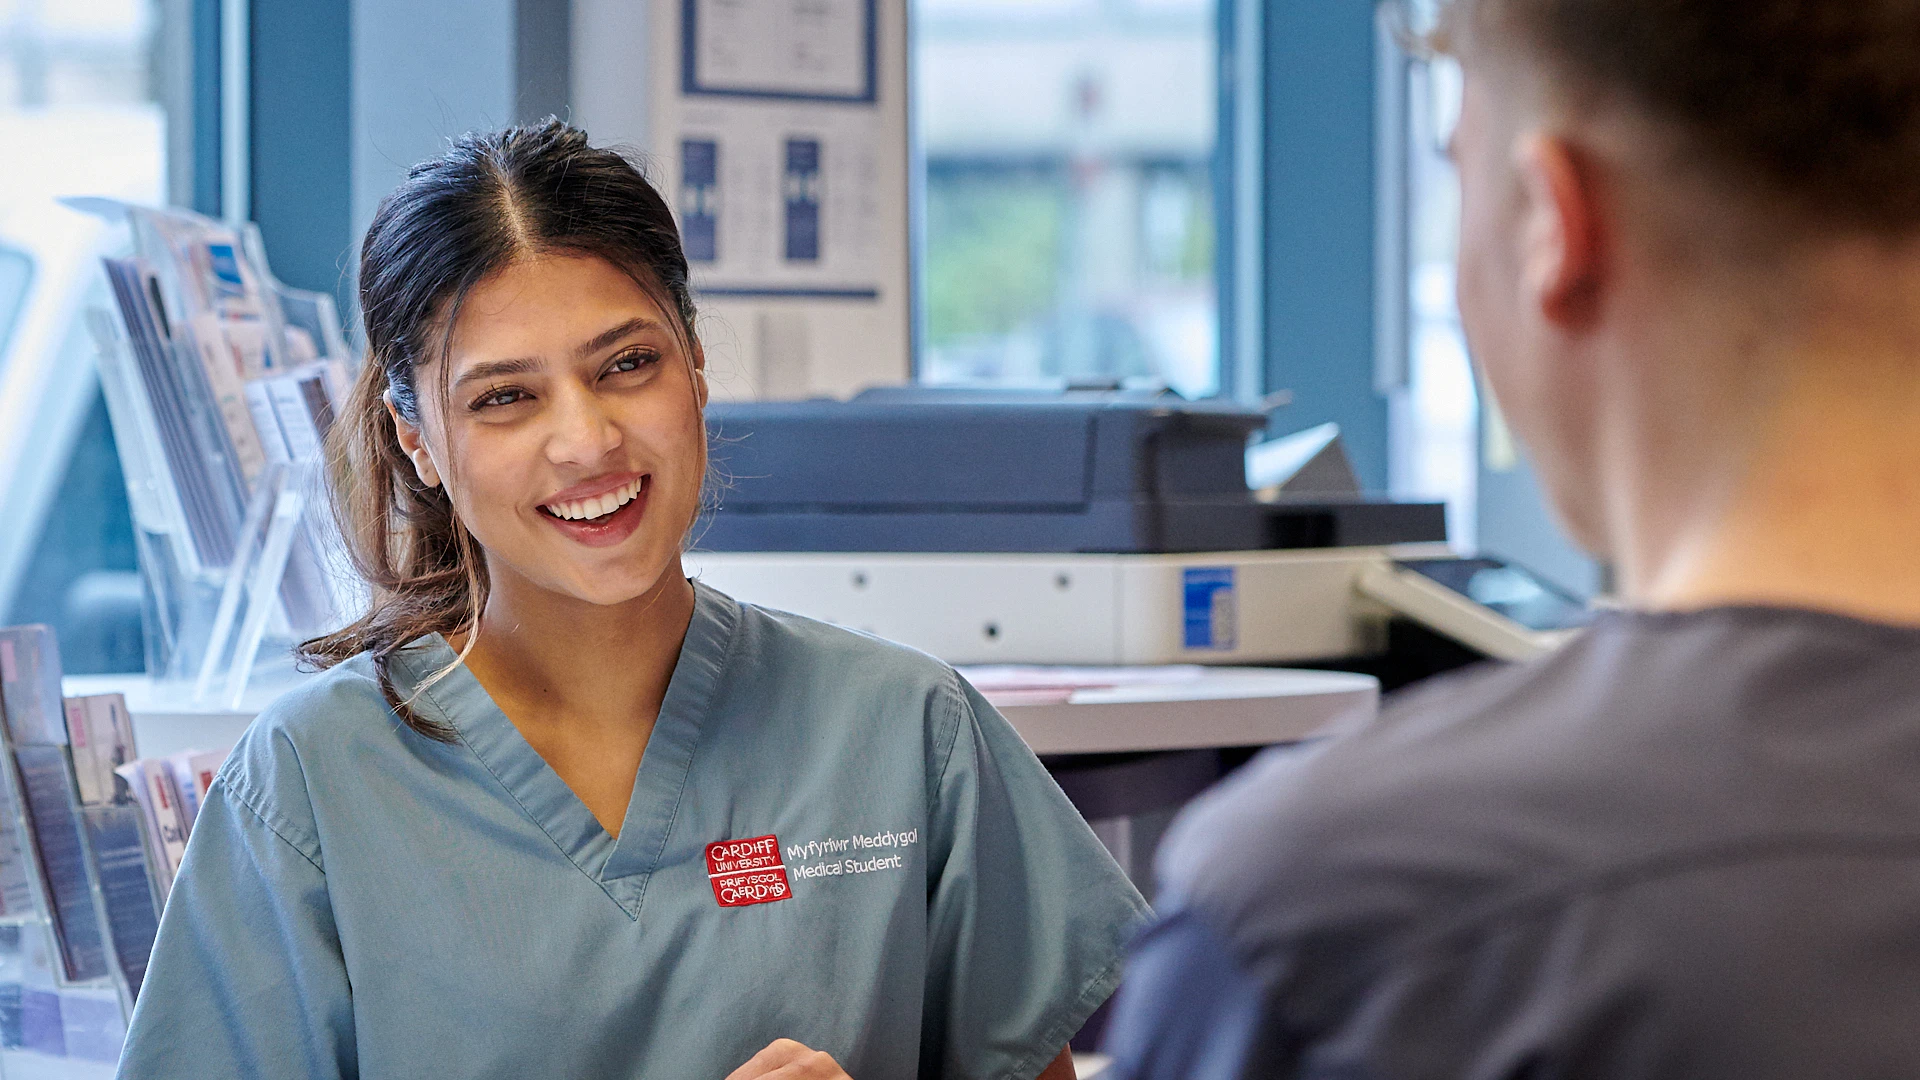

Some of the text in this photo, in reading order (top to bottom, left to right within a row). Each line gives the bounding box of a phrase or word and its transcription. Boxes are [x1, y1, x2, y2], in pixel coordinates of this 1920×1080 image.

[711, 839, 775, 861] CARDIFF
[787, 828, 918, 860] Myfyriwr Meddygol
[715, 856, 775, 872] UNIVERSITY
[793, 854, 902, 881] Medical Student
[719, 873, 782, 888] PRIFYSGOL
